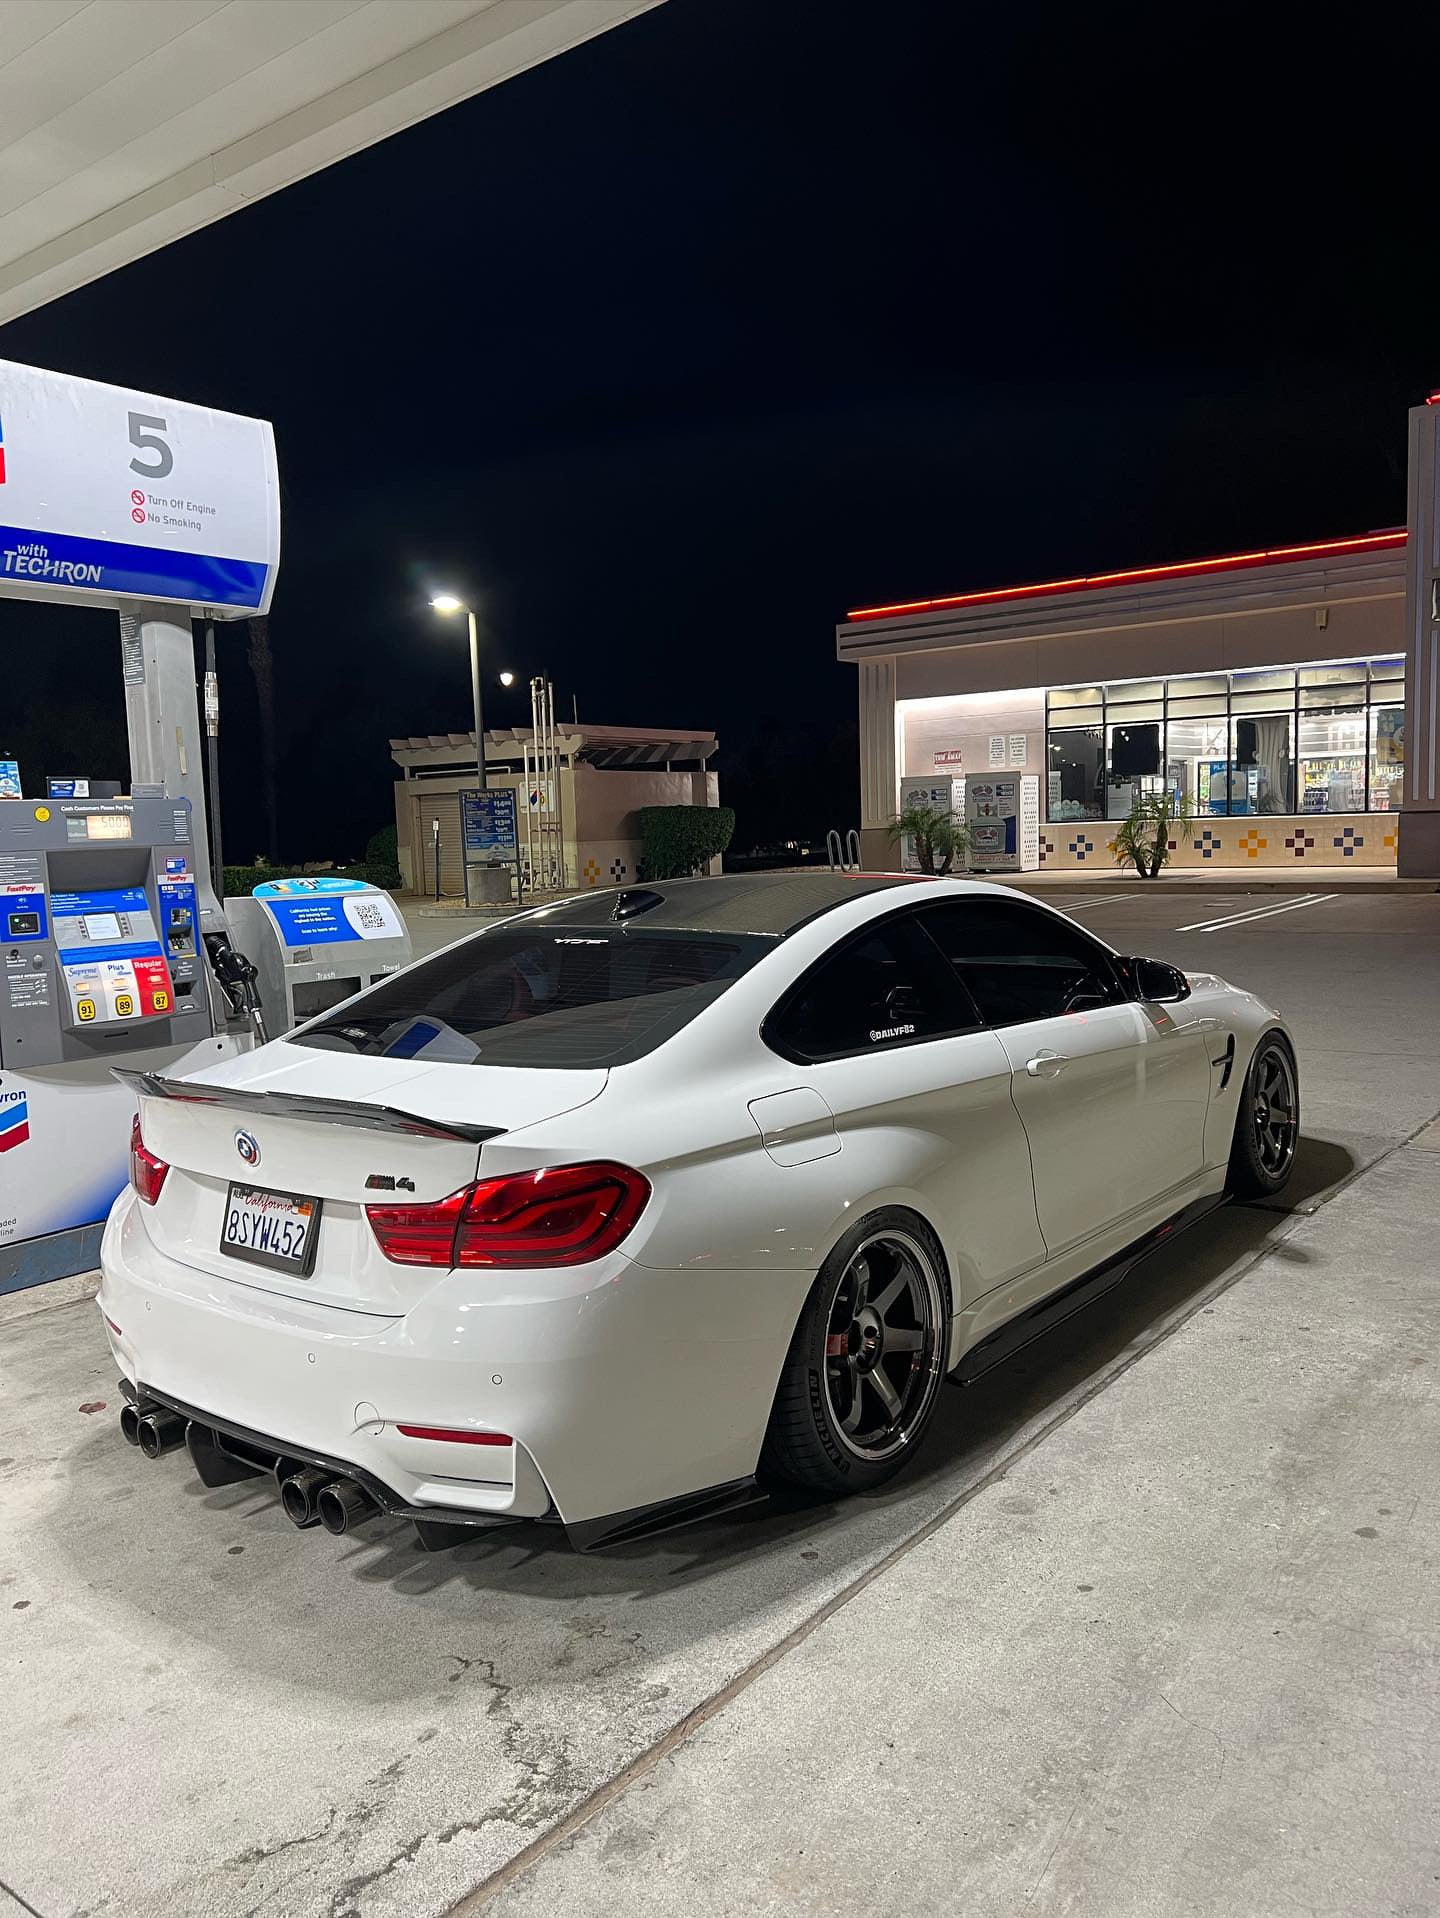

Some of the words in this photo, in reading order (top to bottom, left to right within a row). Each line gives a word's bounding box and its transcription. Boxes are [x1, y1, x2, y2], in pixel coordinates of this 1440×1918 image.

[128, 411, 173, 479] 5
[148, 495, 168, 507] Turn
[170, 499, 184, 510] Off
[187, 502, 216, 515] Engine
[148, 513, 161, 523] No
[163, 516, 202, 532] Smoking
[17, 544, 48, 557] with
[3, 550, 102, 583] TECHRON
[6, 885, 36, 893] FastPay
[107, 964, 125, 972] Plus
[133, 960, 163, 969] Regular
[68, 967, 97, 977] Supreme
[316, 972, 336, 980] Trash
[120, 1001, 130, 1011] 89
[155, 996, 166, 1006] 87
[81, 1006, 92, 1015] 91
[245, 1192, 294, 1214] California
[227, 1209, 306, 1259] 8SYW452
